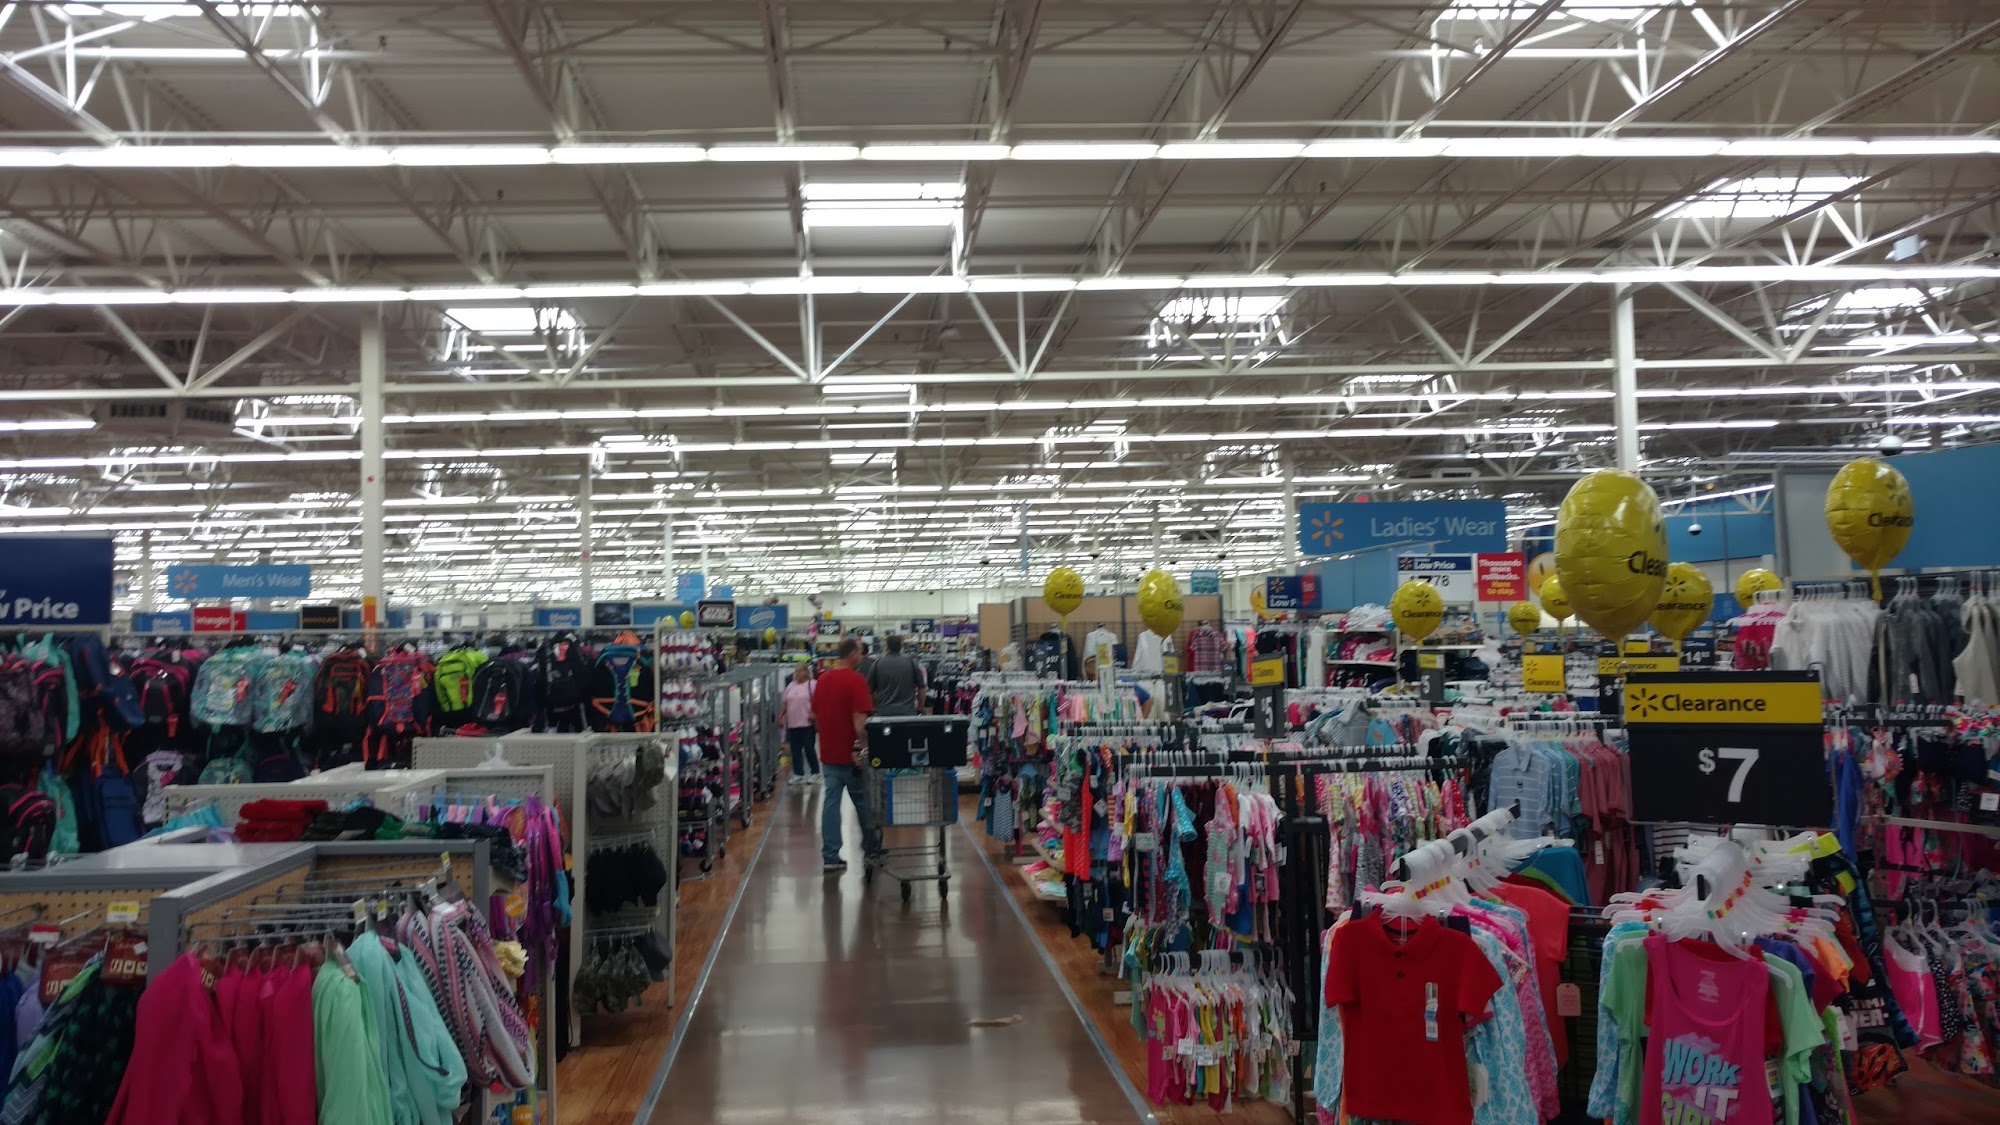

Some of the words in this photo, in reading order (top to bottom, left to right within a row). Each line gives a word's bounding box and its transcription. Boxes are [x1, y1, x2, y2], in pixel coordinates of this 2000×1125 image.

[1371, 517, 1439, 537] Ladies'
[1445, 516, 1496, 536] Wear
[1414, 560, 1432, 570] Low
[1433, 561, 1456, 570] Price
[1479, 559, 1522, 567] Thousands
[222, 573, 264, 588] Men's
[267, 573, 303, 588] Wear
[14, 596, 80, 620] Price
[1270, 599, 1288, 608] Low
[1526, 678, 1560, 687] Clearance
[1661, 693, 1767, 712] Clearance
[1697, 747, 1760, 803] $7
[1664, 1038, 1741, 1086] WORK
[1695, 1086, 1739, 1122] IT
